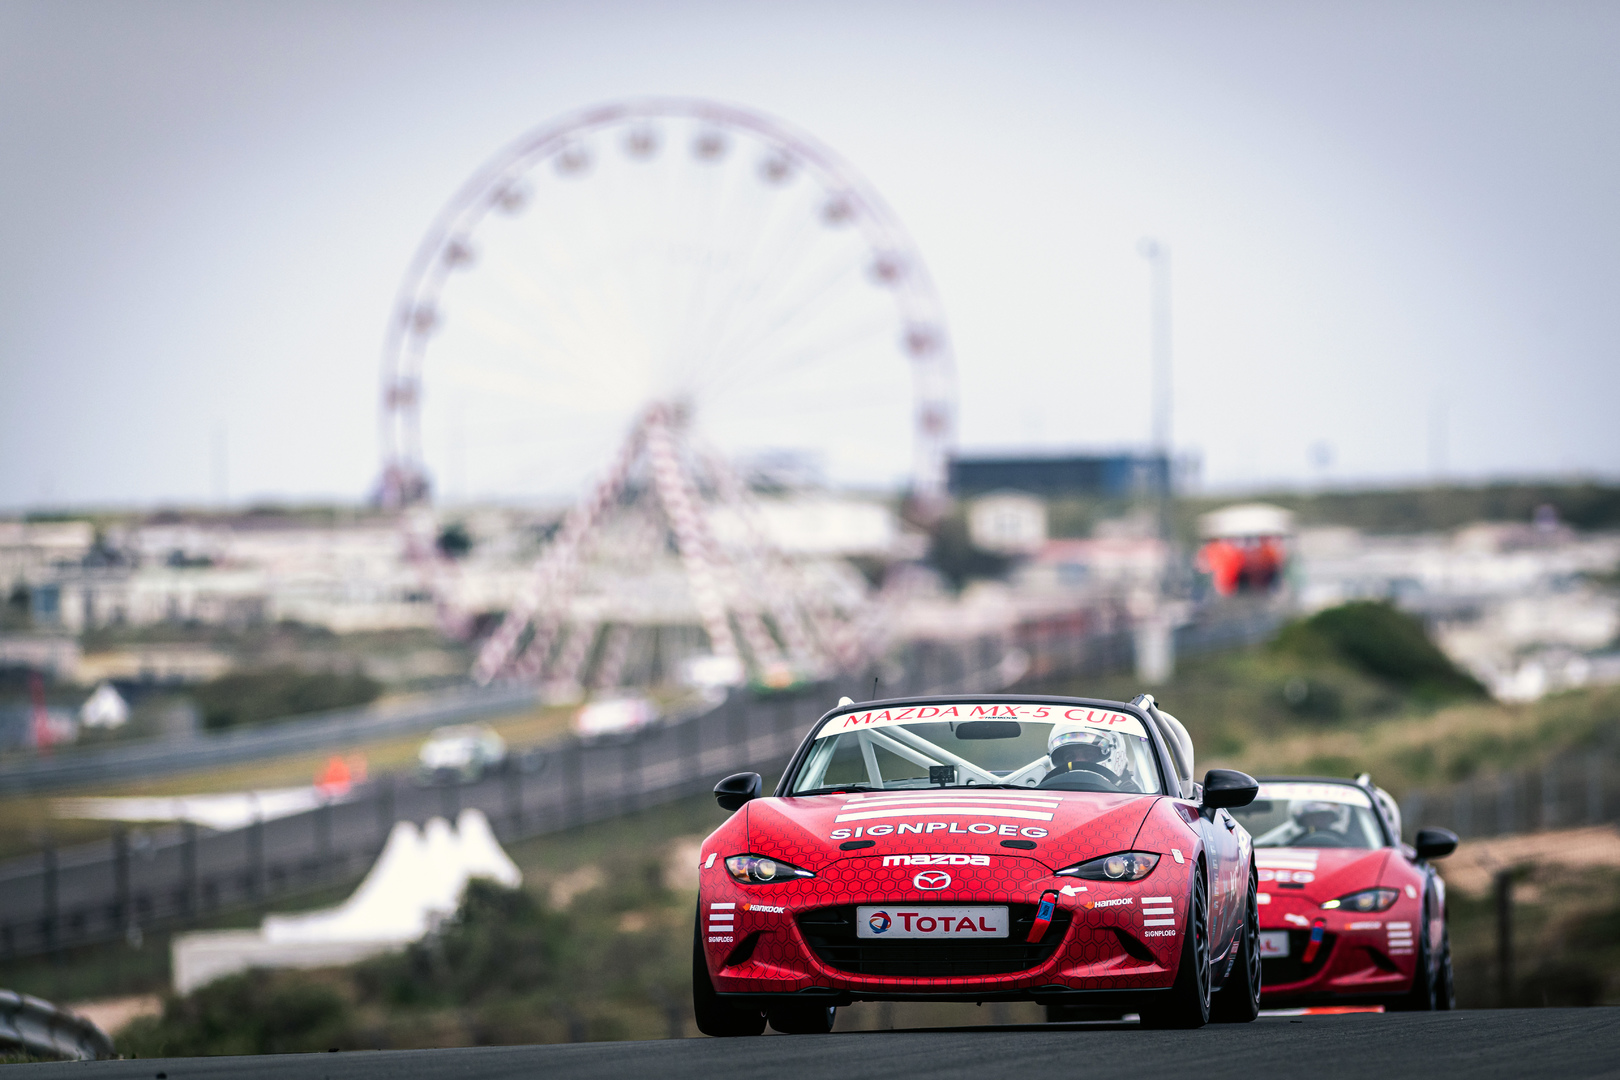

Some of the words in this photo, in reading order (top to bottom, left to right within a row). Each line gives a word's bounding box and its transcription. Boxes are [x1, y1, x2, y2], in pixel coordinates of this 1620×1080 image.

[843, 706, 959, 728] MAZDA
[969, 705, 1051, 718] MX-5
[1065, 709, 1127, 726] CUP
[829, 822, 1049, 840] SIGNPLOEG
[882, 854, 990, 867] mazda
[897, 912, 996, 932] TOTAL
[708, 935, 733, 943] SIGNPLOEG
[1144, 929, 1176, 938] SIGNPLOEG
